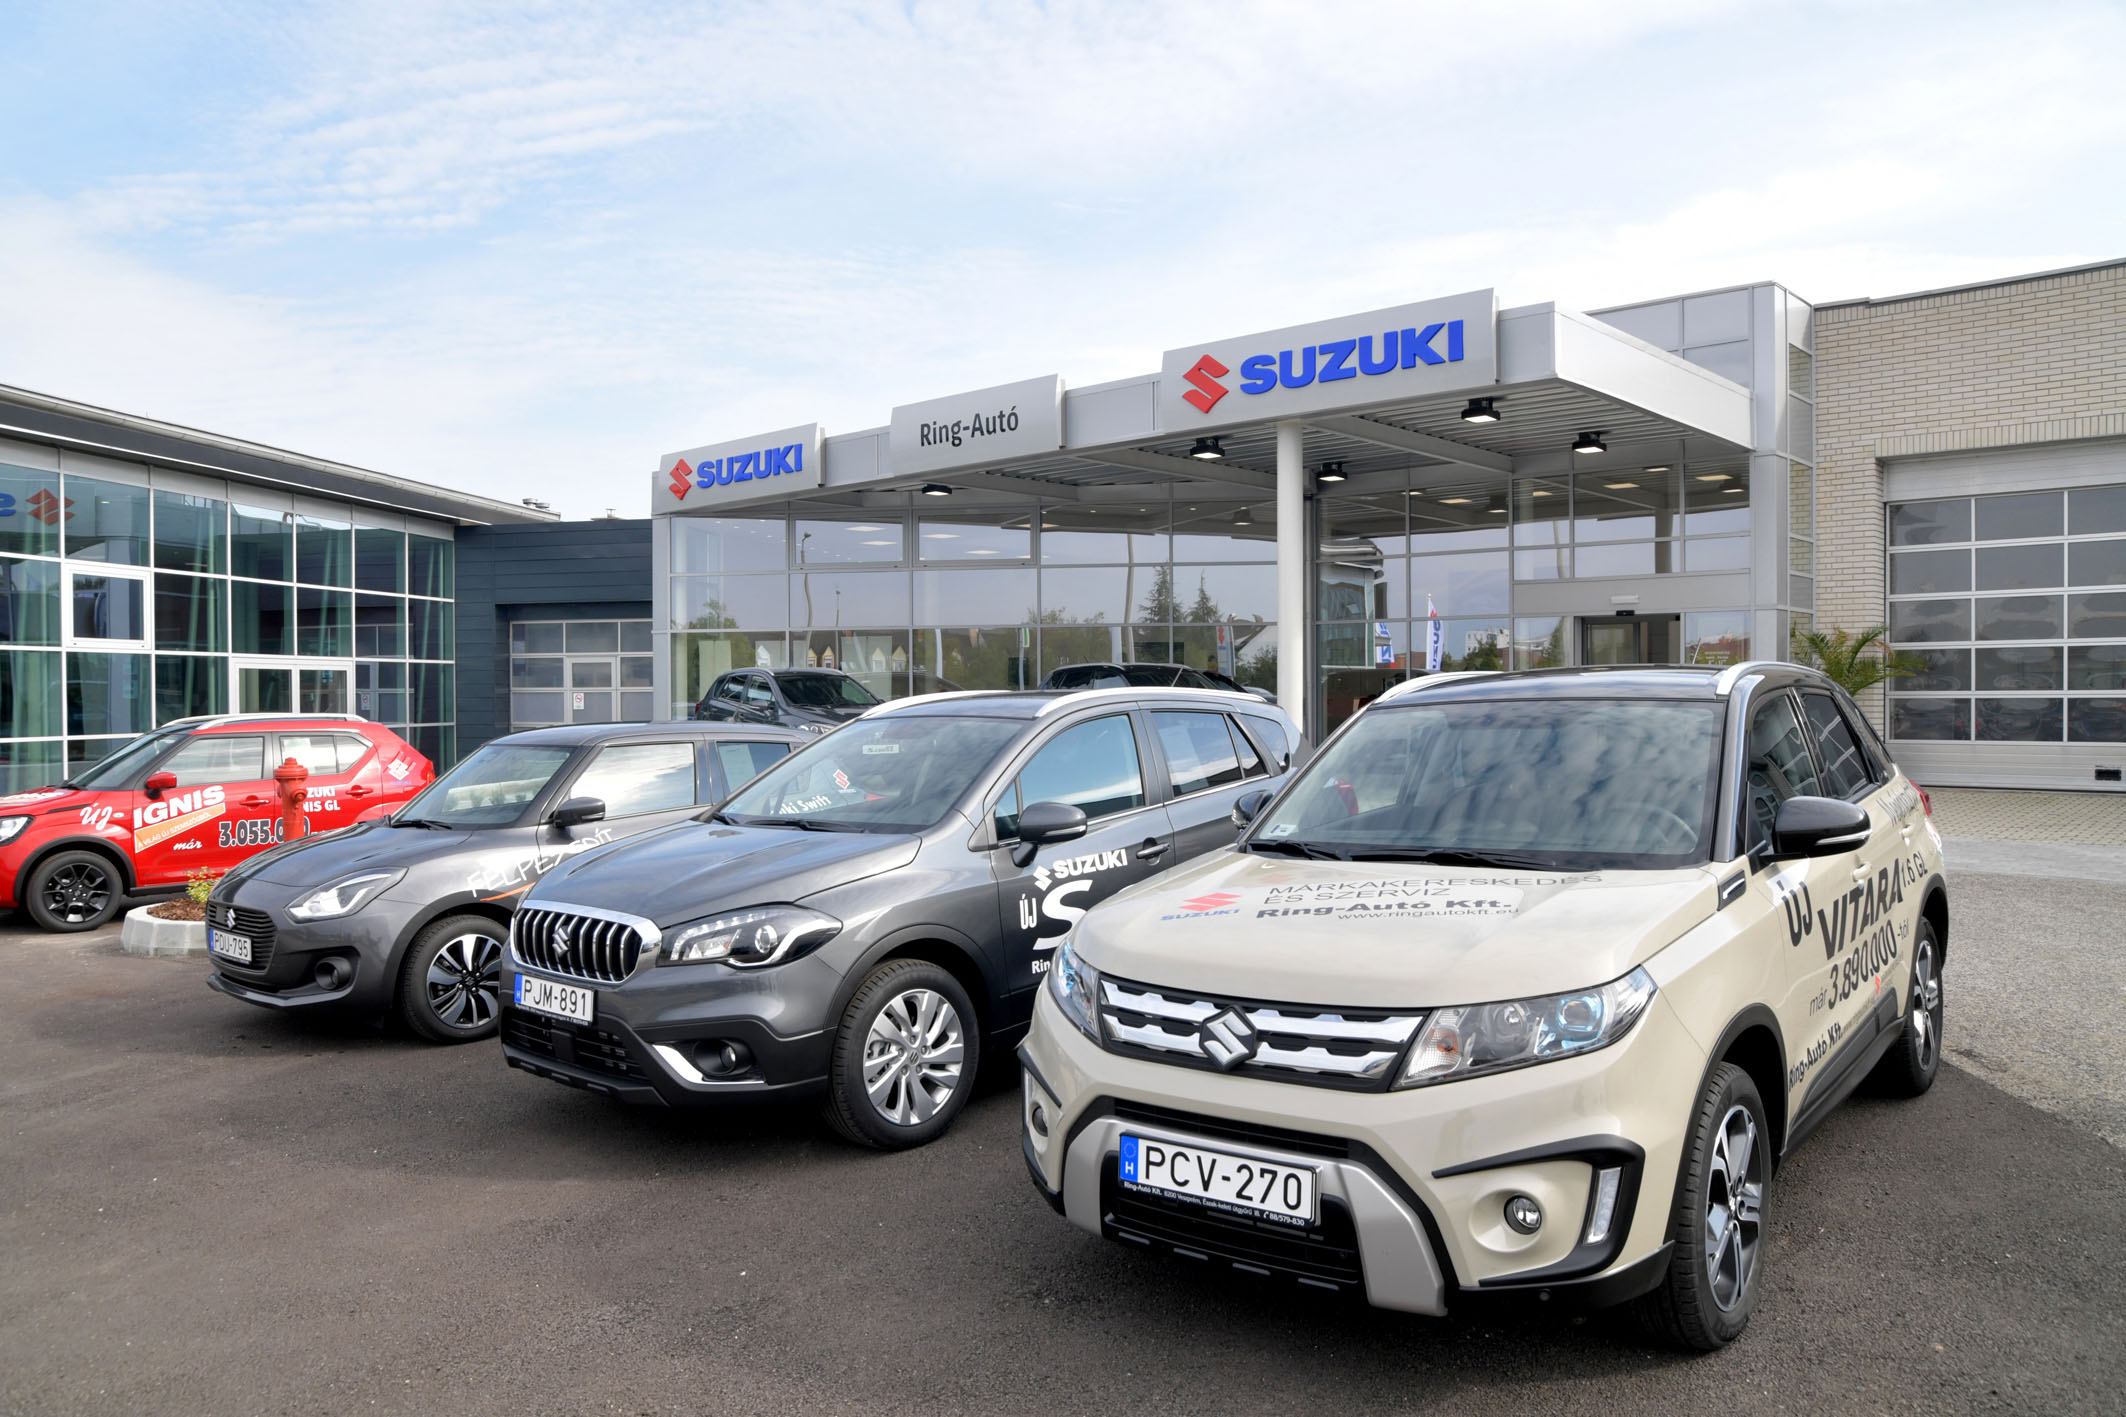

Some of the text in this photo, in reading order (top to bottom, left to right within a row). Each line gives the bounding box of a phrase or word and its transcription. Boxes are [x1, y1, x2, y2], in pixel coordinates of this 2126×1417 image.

[1240, 319, 1464, 395] SUZUKI
[920, 405, 1019, 448] Ring-Autó
[696, 443, 803, 488] SUZUKI
[133, 785, 226, 828] IGNIS
[303, 800, 341, 812] NIS GL
[305, 787, 336, 798] ZUKI
[173, 839, 203, 850] már
[219, 816, 310, 847] 3.055.00
[1053, 849, 1128, 879] SUZUKI
[1019, 893, 1038, 930] ÚJ
[1256, 899, 1512, 919] Ring-Autó Kft.
[1314, 887, 1451, 901] SZERVIZ
[1817, 851, 1928, 960] VITARA 1.6 GL
[1160, 908, 1241, 921] SUZUKI
[1337, 907, 1519, 920] www.ringautokft.eu
[1777, 880, 1813, 947] ÚJ
[214, 931, 249, 958] PDU-795
[1828, 920, 1897, 1010] 3.890.000
[523, 979, 586, 1017] PJM-891
[1788, 1033, 1828, 1093] Ring-Autó
[1125, 1145, 1302, 1211] H PCV-270
[1123, 1181, 1151, 1193] Ring-Autó
[1269, 1212, 1305, 1226] 88/579-830
